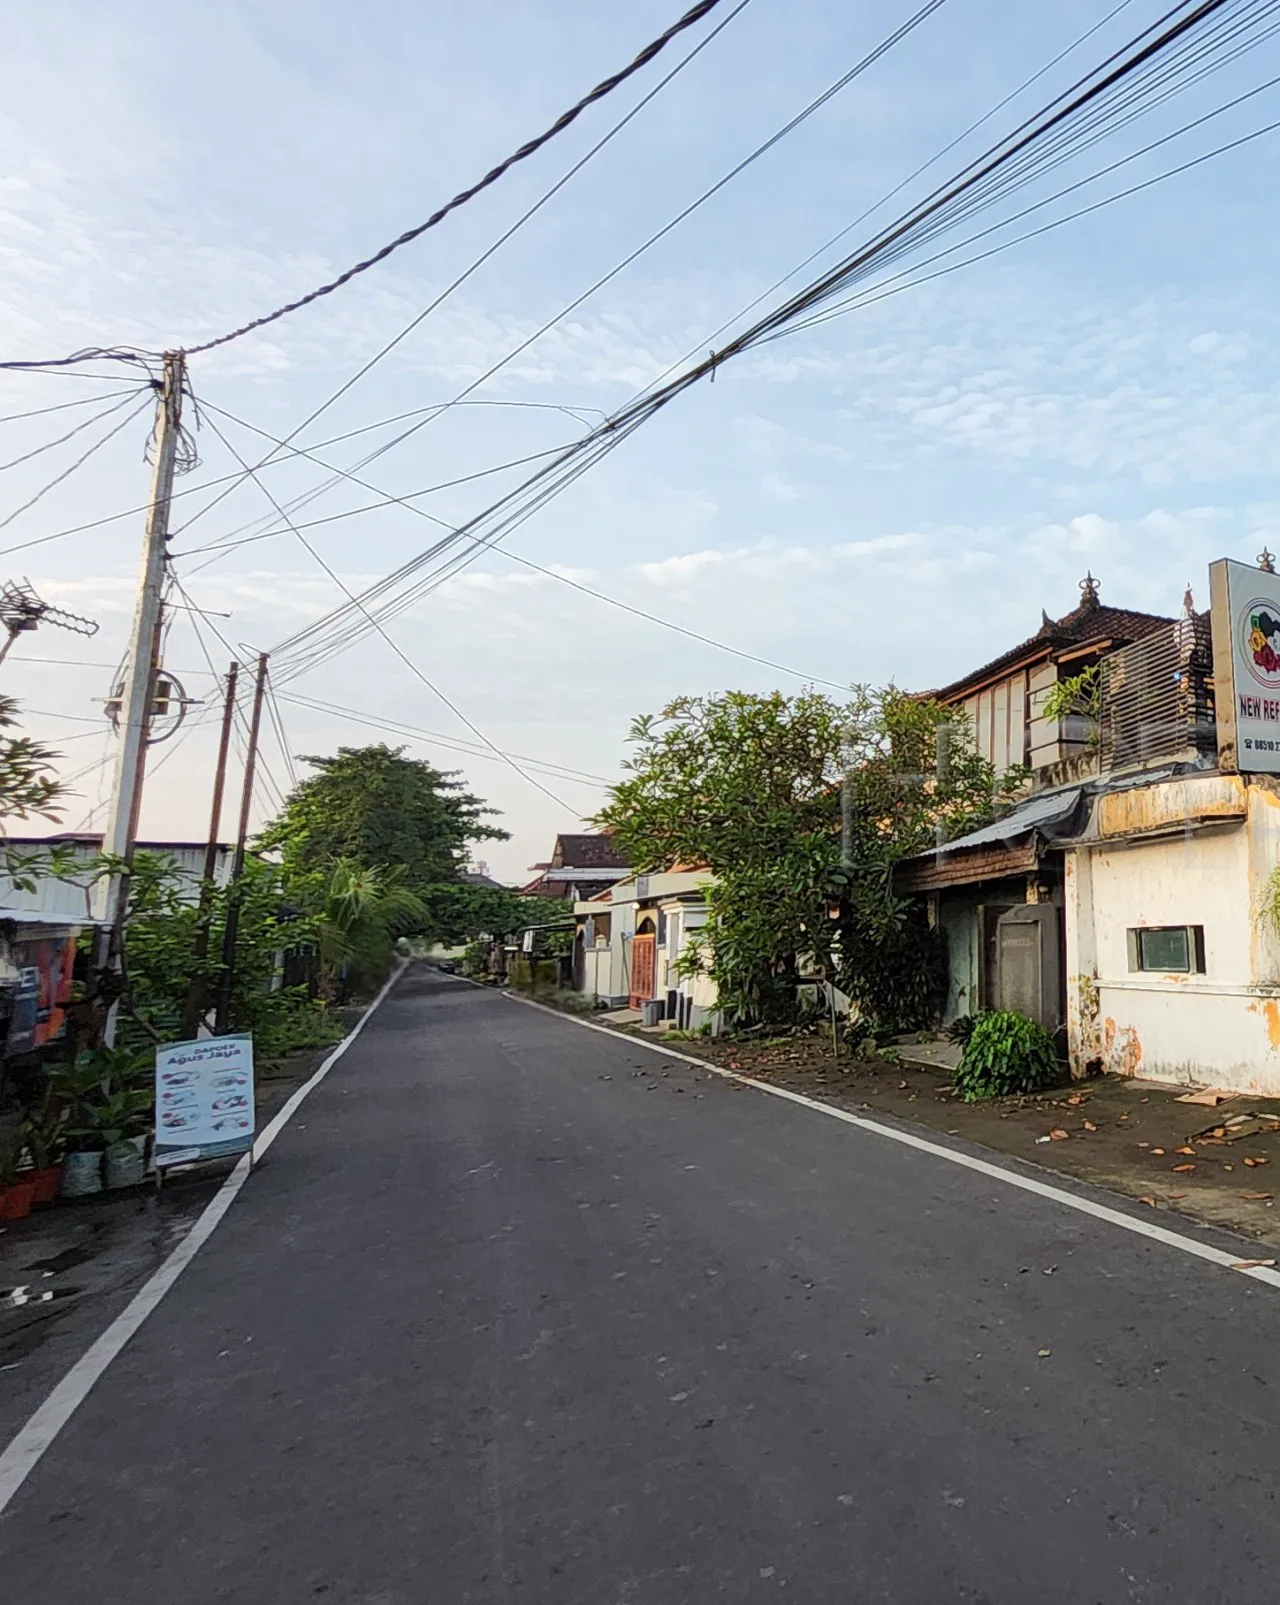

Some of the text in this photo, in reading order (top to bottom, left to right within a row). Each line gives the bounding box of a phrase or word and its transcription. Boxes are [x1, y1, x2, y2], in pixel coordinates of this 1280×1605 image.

[1240, 696, 1261, 718] NEW
[167, 1054, 204, 1066] Agus
[207, 1048, 242, 1060] Jaya
